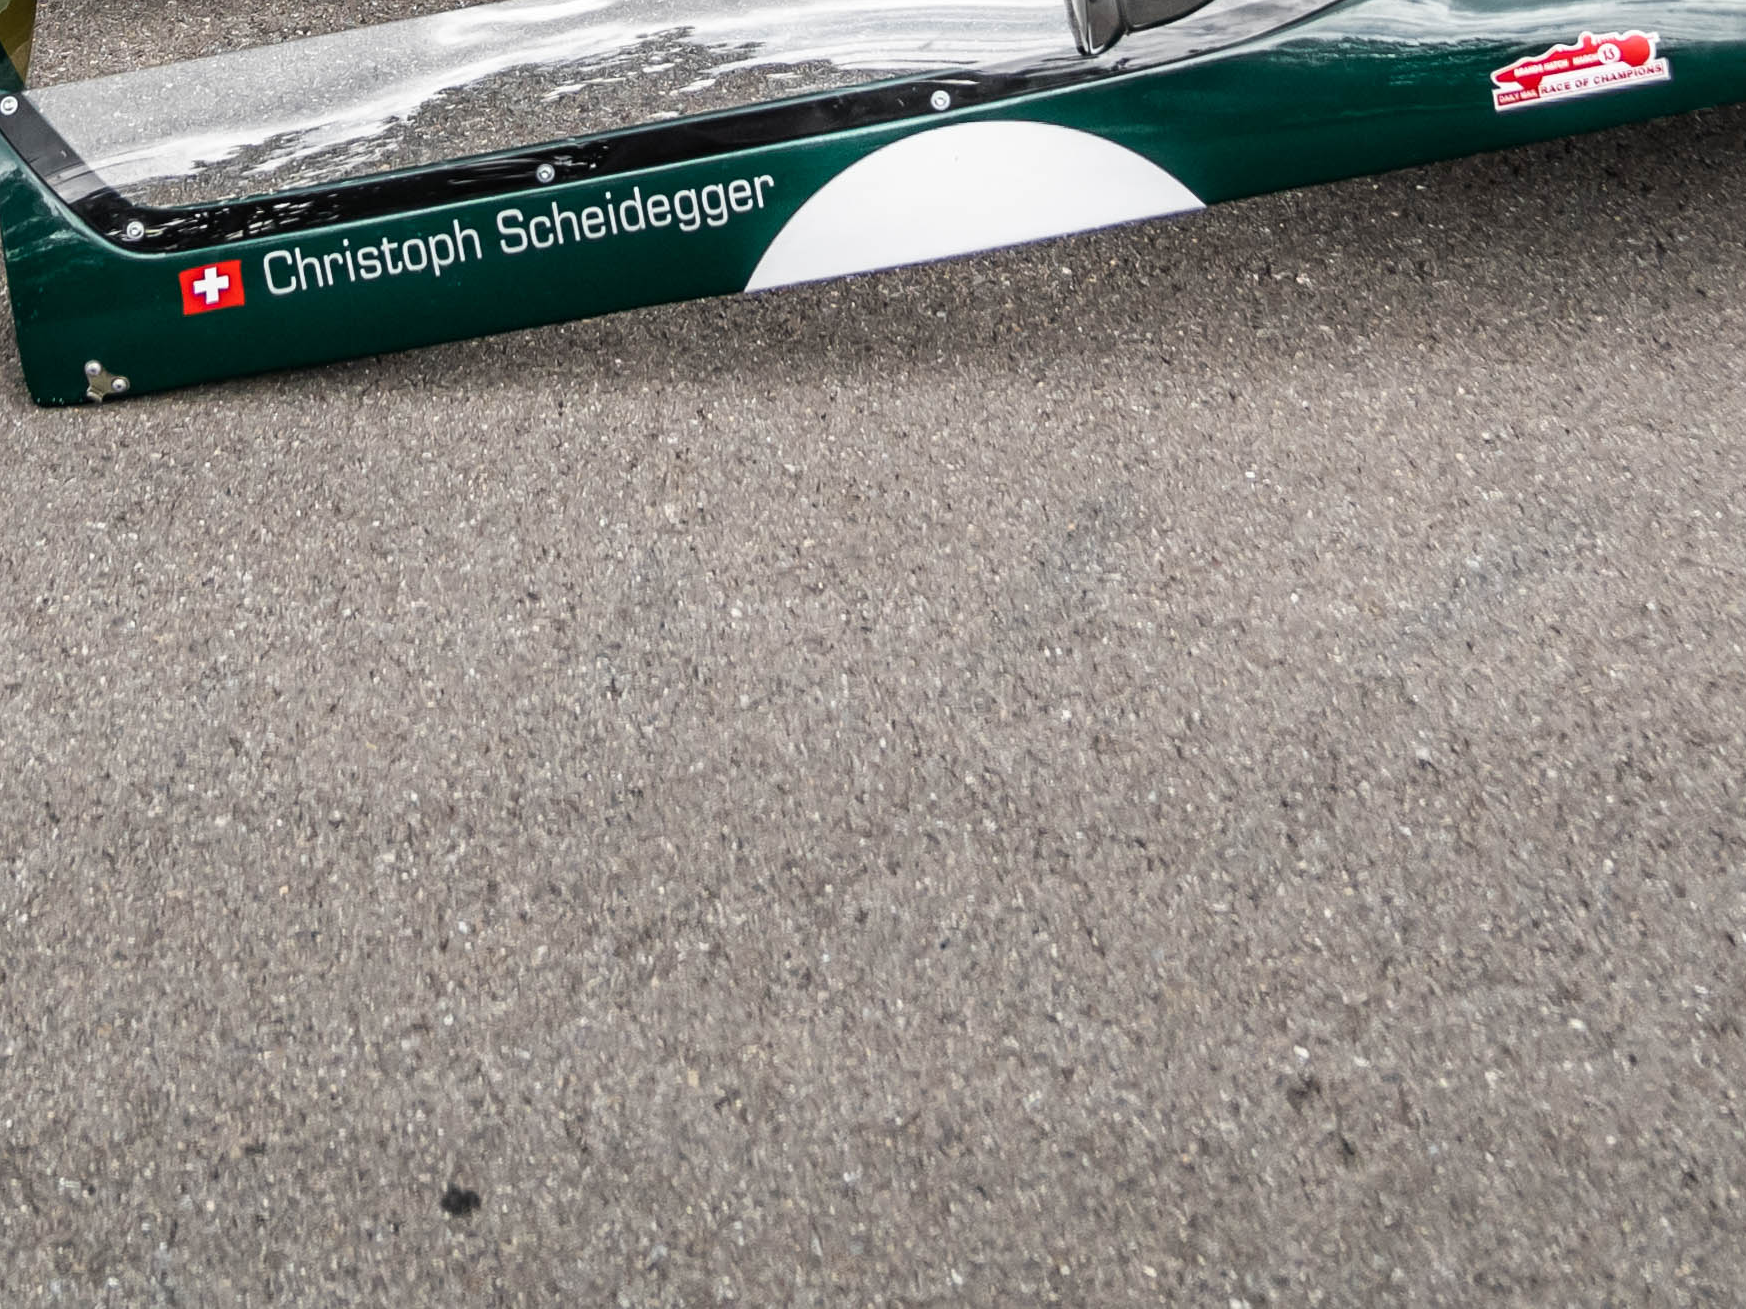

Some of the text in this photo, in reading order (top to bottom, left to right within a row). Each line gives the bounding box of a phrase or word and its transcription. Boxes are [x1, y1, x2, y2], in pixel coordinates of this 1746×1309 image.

[1540, 64, 1663, 95] RACE OF CHAMPIONS
[262, 174, 775, 297] Christoph Scheidegger
